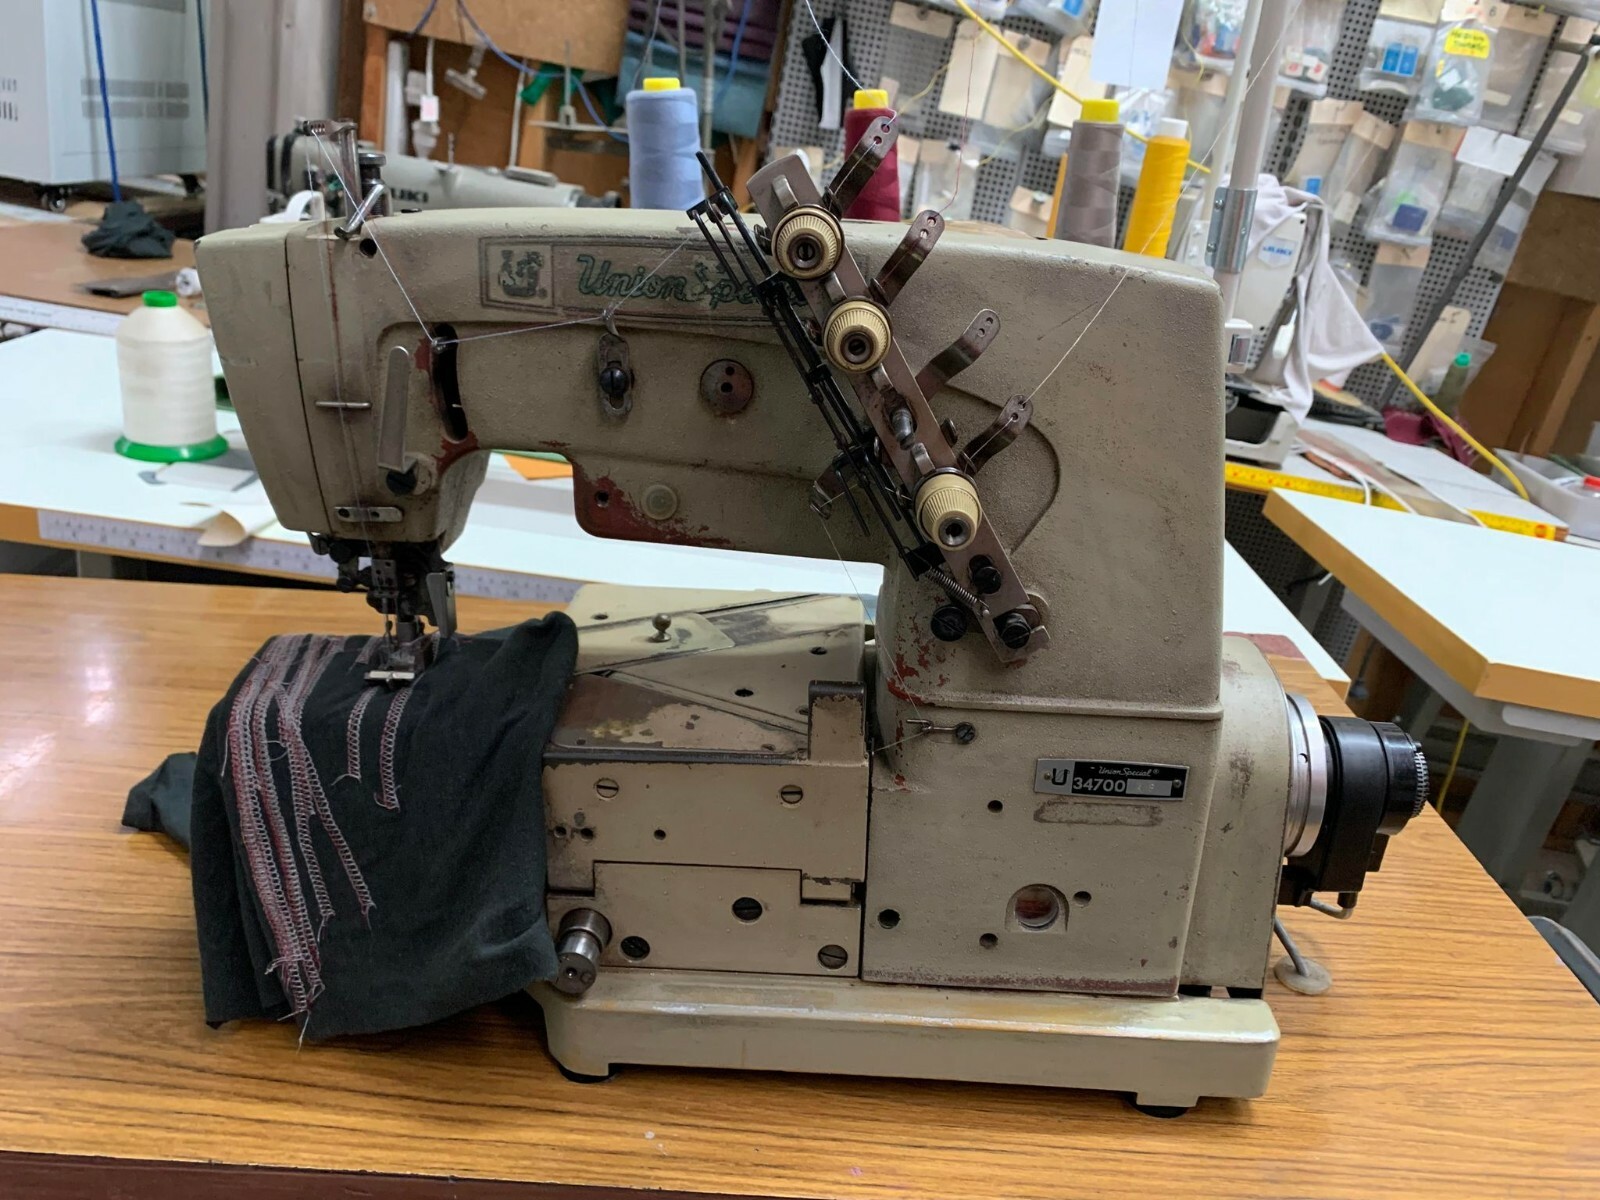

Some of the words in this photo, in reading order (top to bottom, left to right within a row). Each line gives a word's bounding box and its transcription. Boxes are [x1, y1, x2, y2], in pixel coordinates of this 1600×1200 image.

[390, 187, 429, 204] UKI
[577, 253, 688, 300] Union
[1099, 766, 1121, 776] Union
[1073, 777, 1126, 793] 34700
